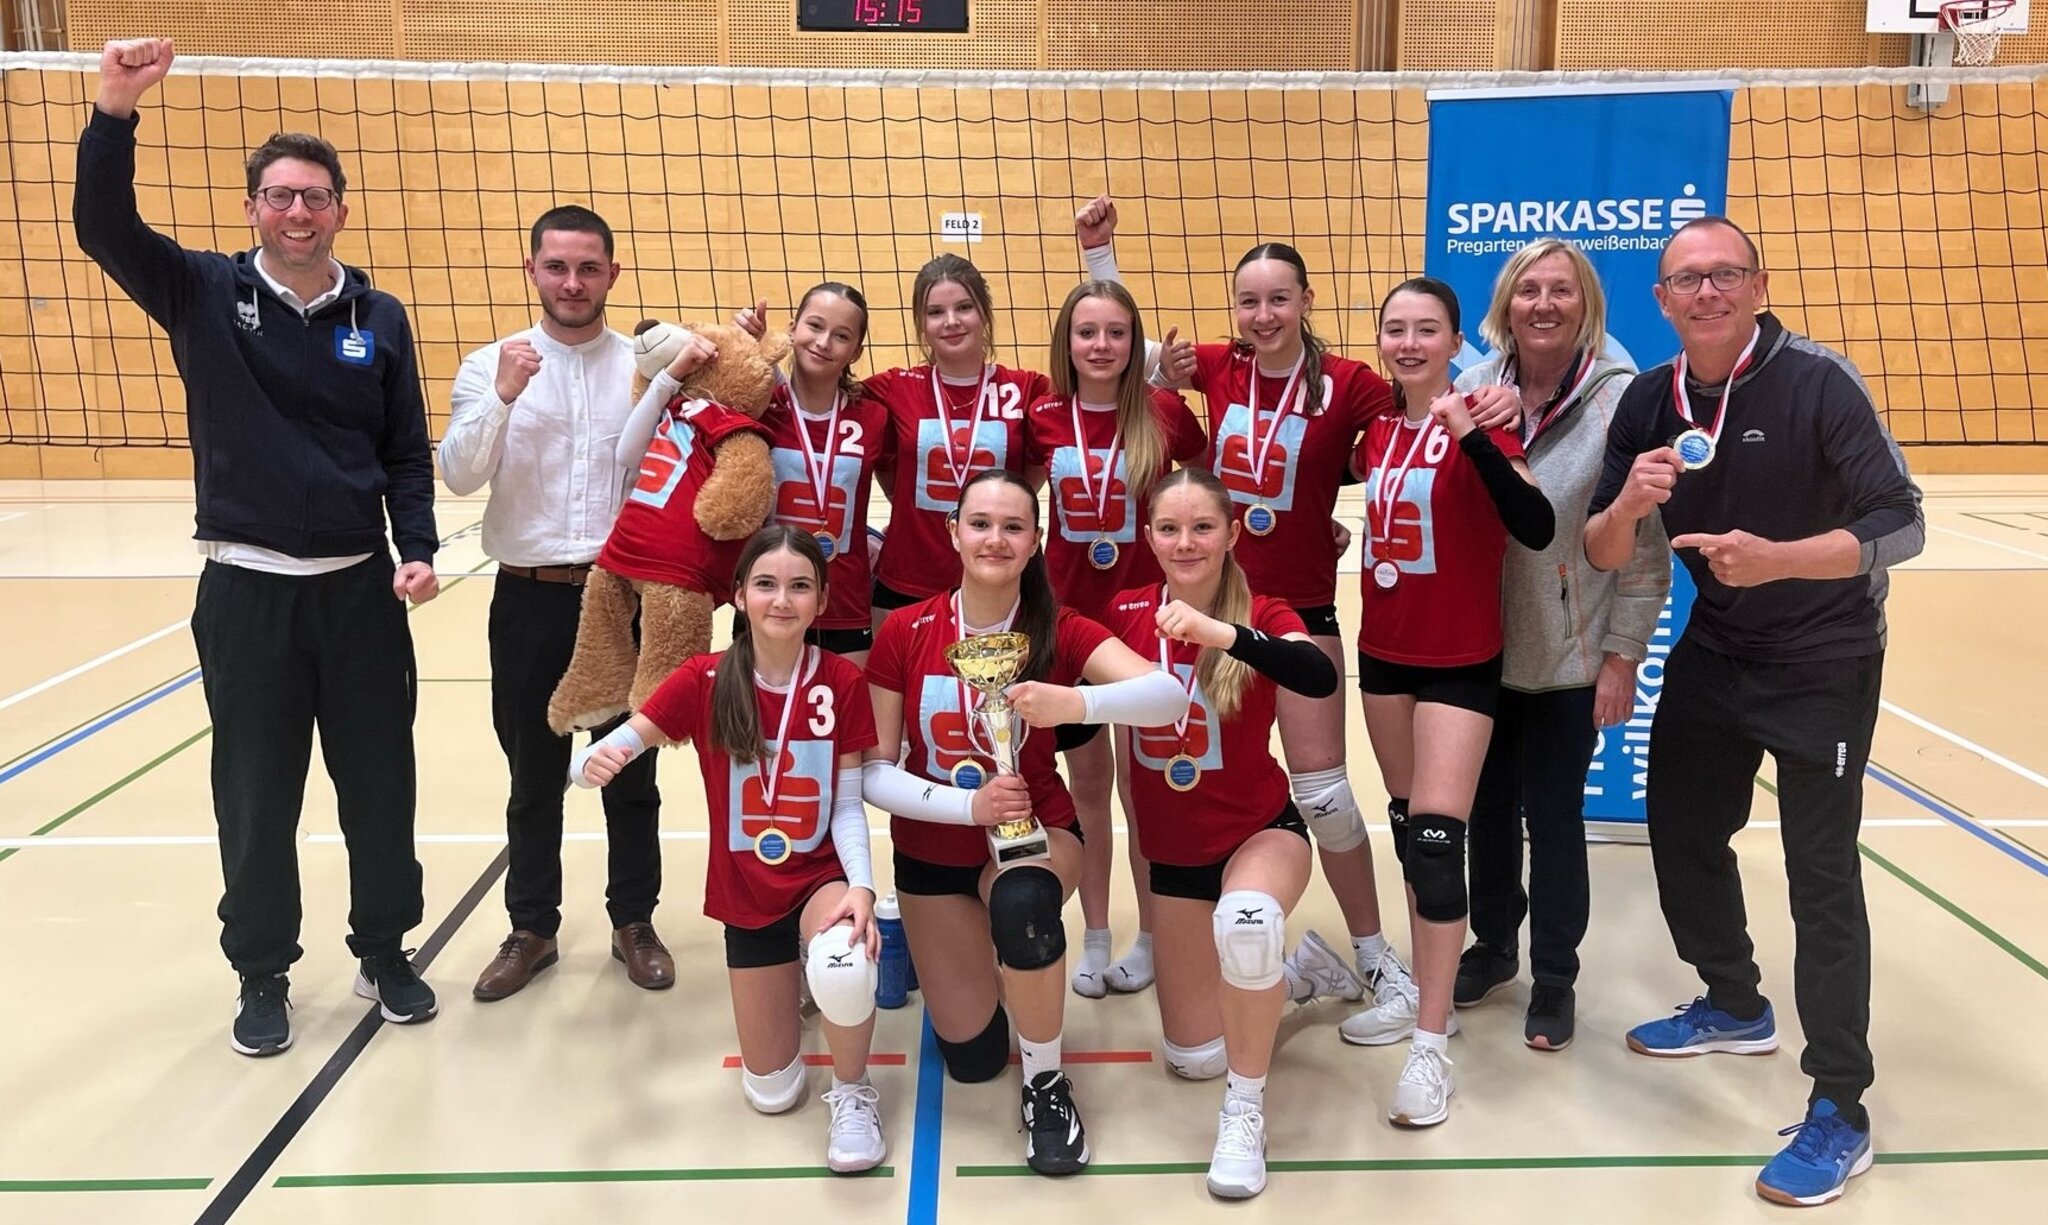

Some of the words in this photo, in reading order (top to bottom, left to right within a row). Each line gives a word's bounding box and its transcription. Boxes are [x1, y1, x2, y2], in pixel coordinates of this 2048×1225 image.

[945, 219, 970, 229] FELD
[972, 220, 979, 229] 2
[1447, 199, 1664, 234] SPARKASSE
[985, 382, 1024, 419] 12
[838, 419, 864, 455] 2
[1424, 424, 1450, 464] 6
[807, 684, 836, 737] 3
